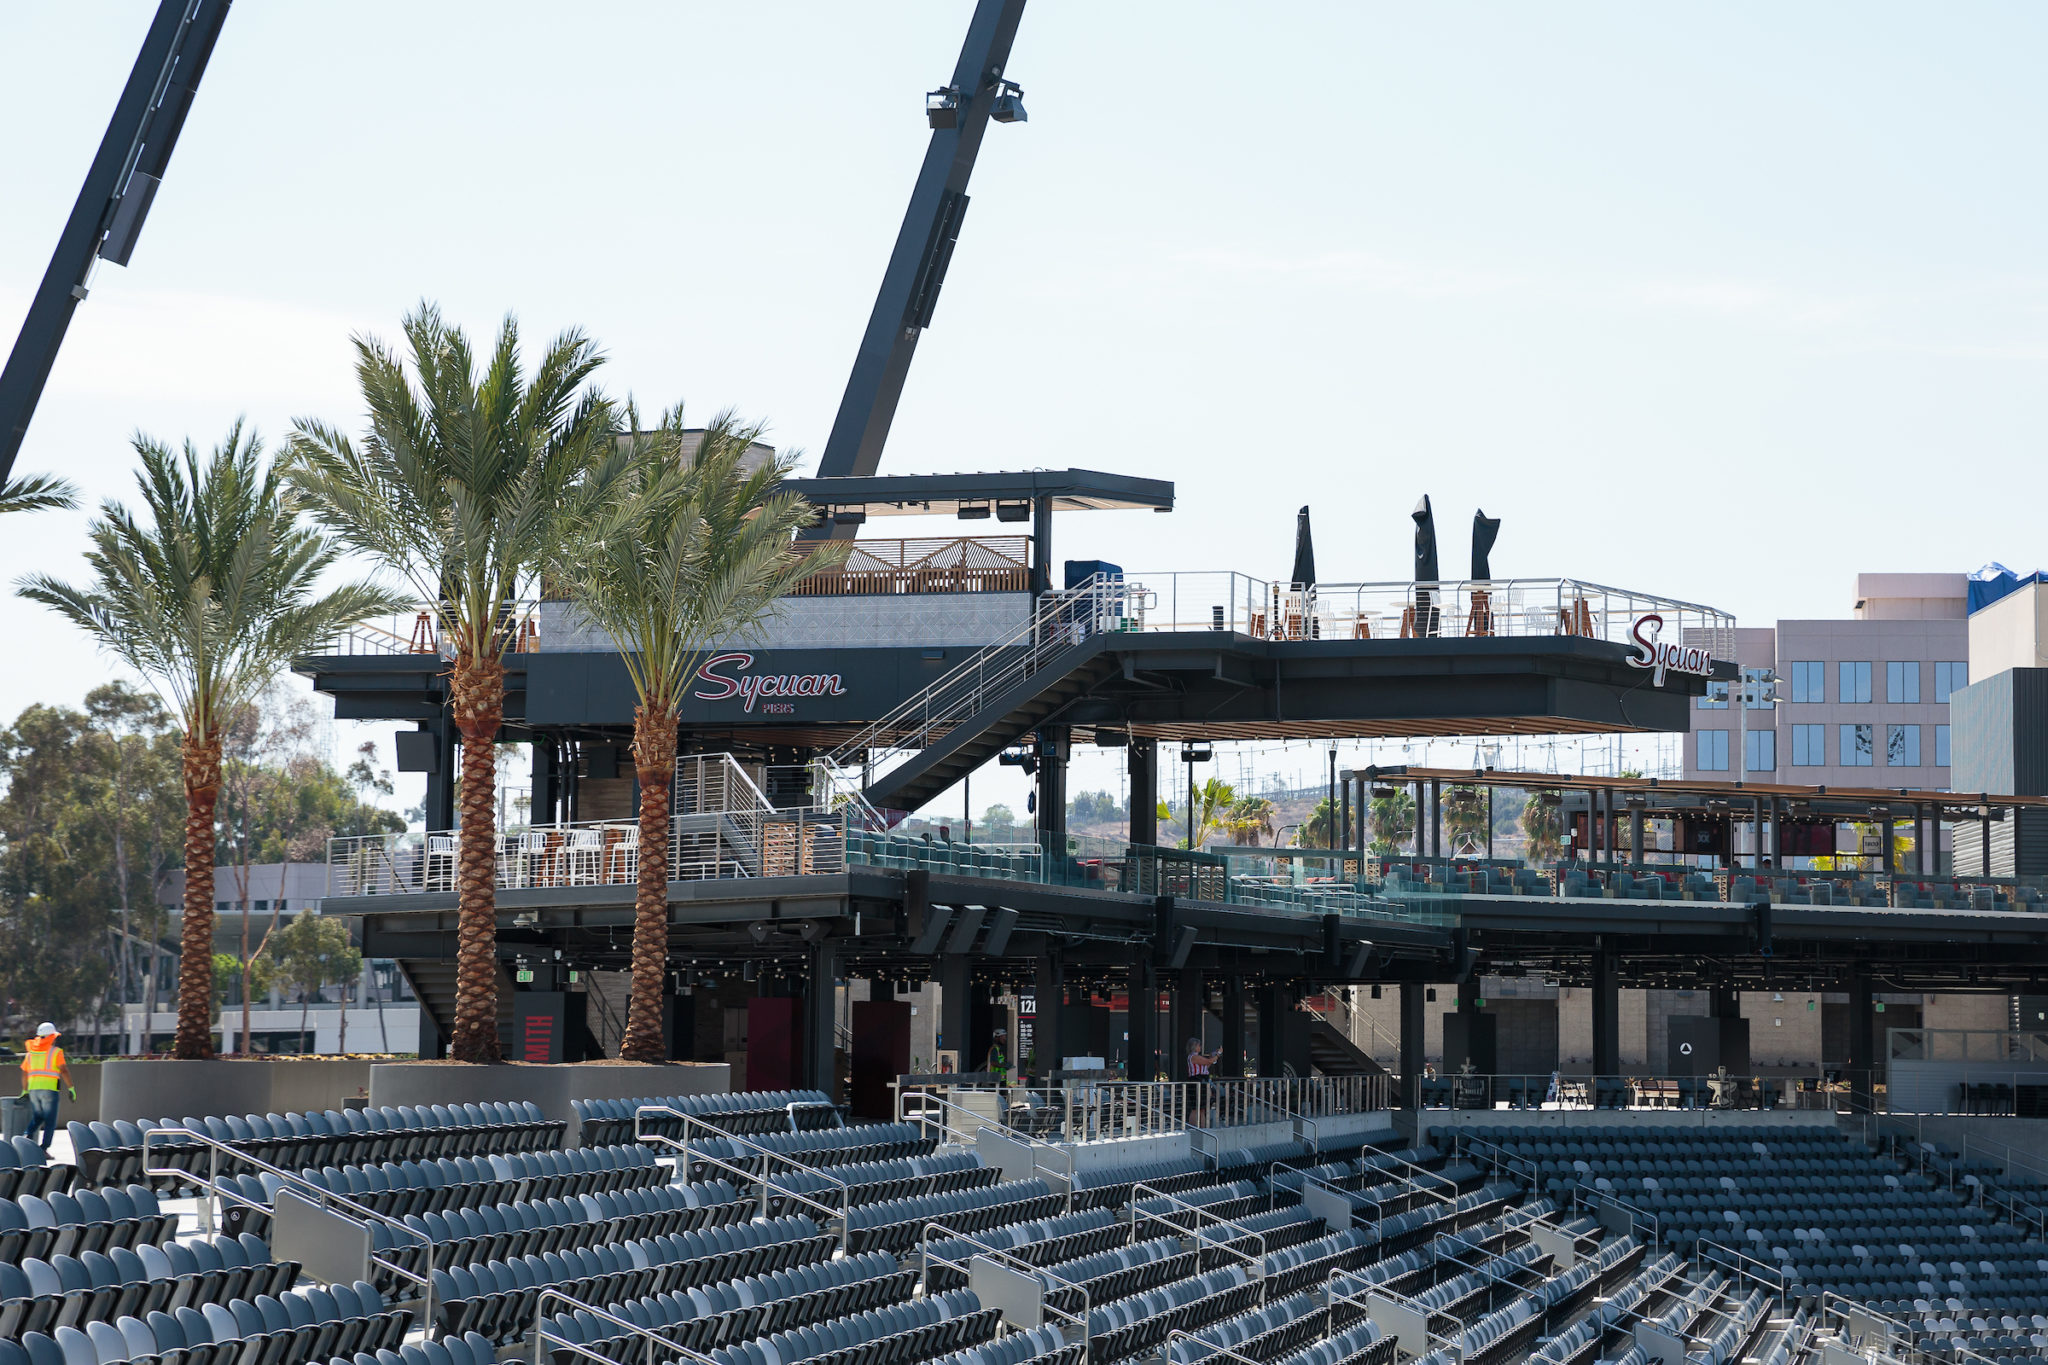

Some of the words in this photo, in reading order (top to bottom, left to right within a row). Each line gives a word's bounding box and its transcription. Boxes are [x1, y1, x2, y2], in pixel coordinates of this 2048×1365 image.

[1626, 614, 1715, 687] Sycuan
[695, 653, 847, 713] Sycuan
[762, 703, 795, 714] PIERS
[1020, 1000, 1036, 1013] 121
[524, 1015, 553, 1062] MITH
